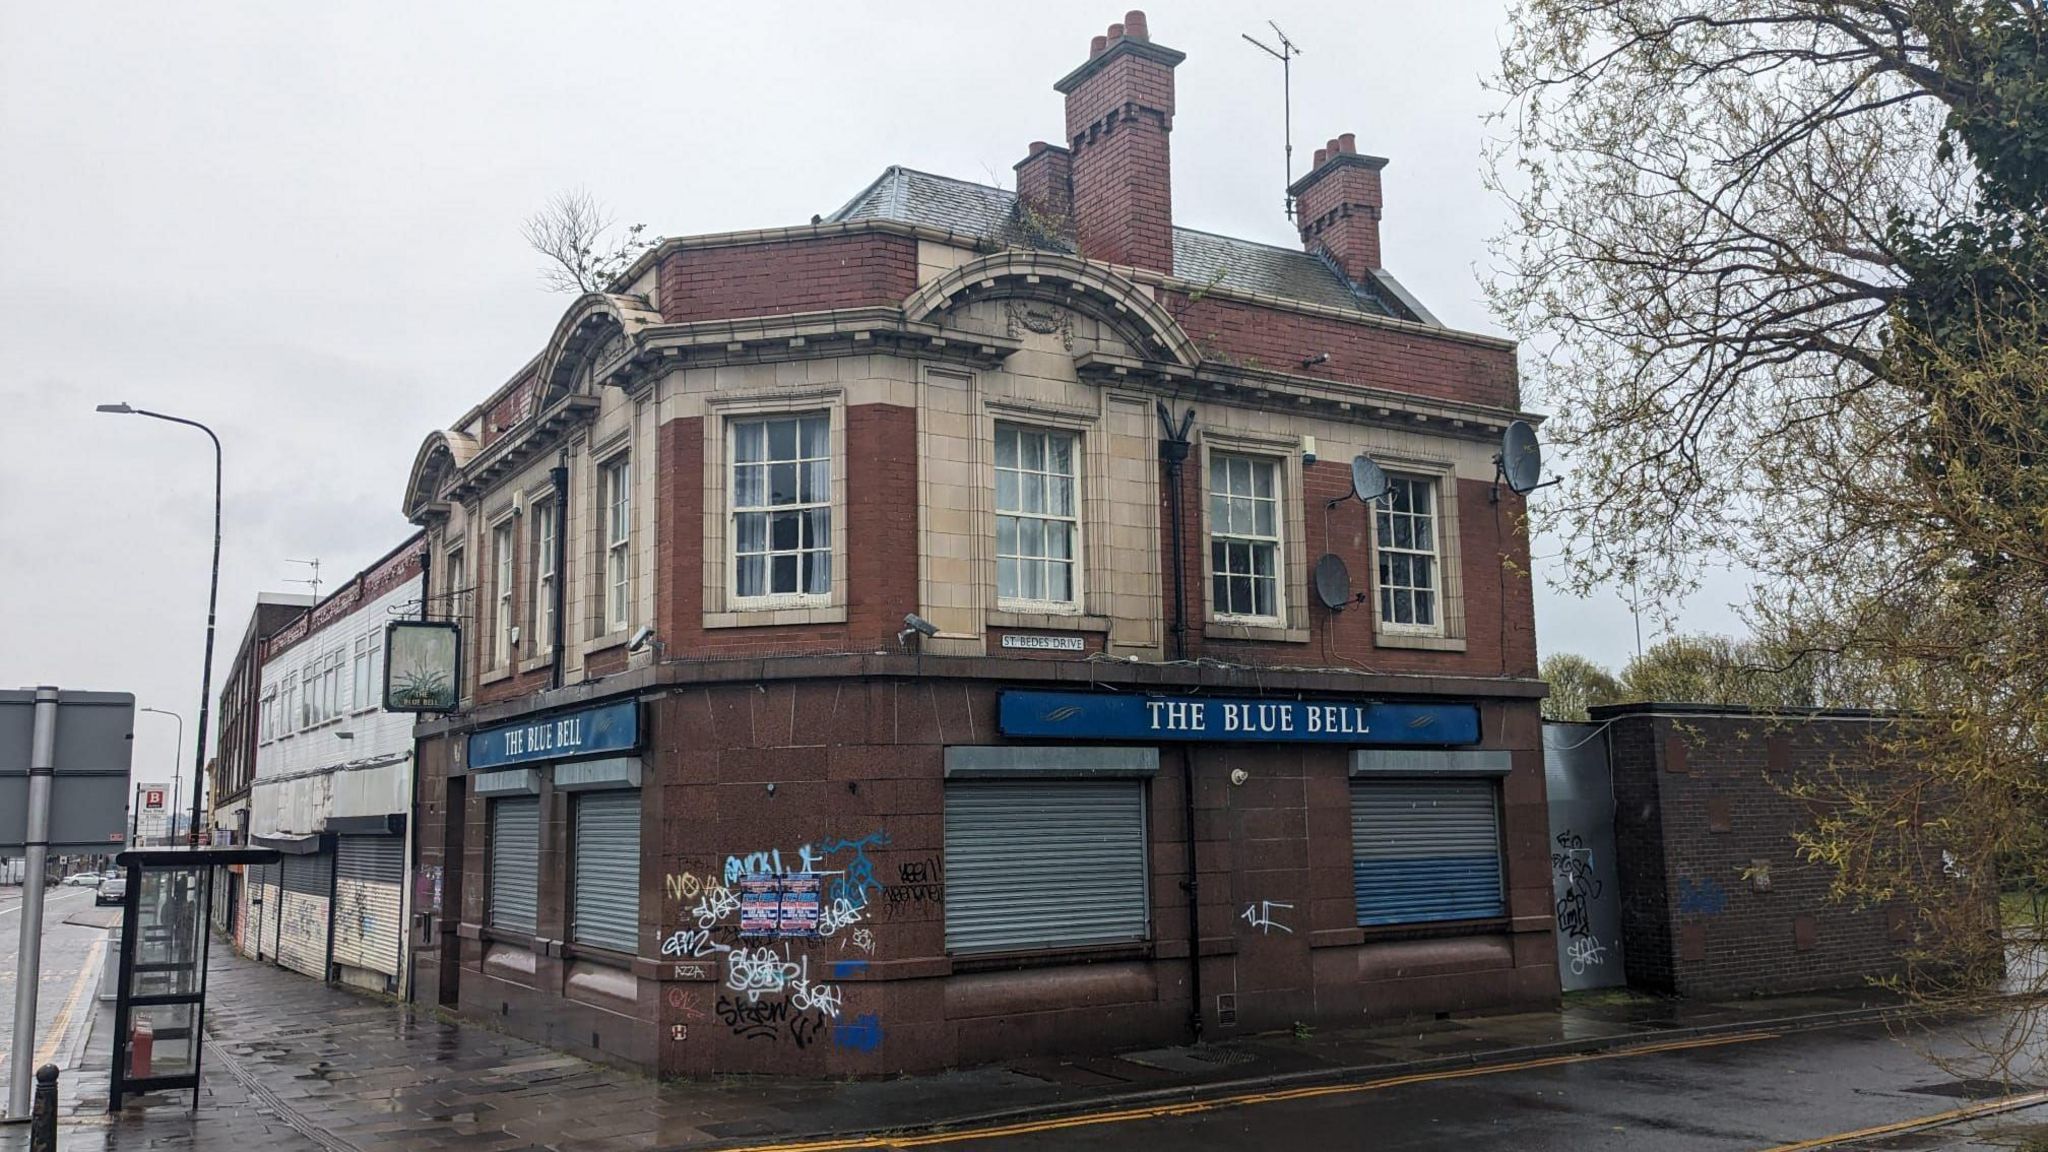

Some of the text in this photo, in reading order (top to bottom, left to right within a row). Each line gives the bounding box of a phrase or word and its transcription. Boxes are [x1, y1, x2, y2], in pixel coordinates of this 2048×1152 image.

[1020, 637, 1049, 648] BEDES
[1053, 638, 1082, 649] DRIVE
[1146, 702, 1369, 733] THE BLUE BELL
[505, 719, 581, 755] THE BLUE BELL
